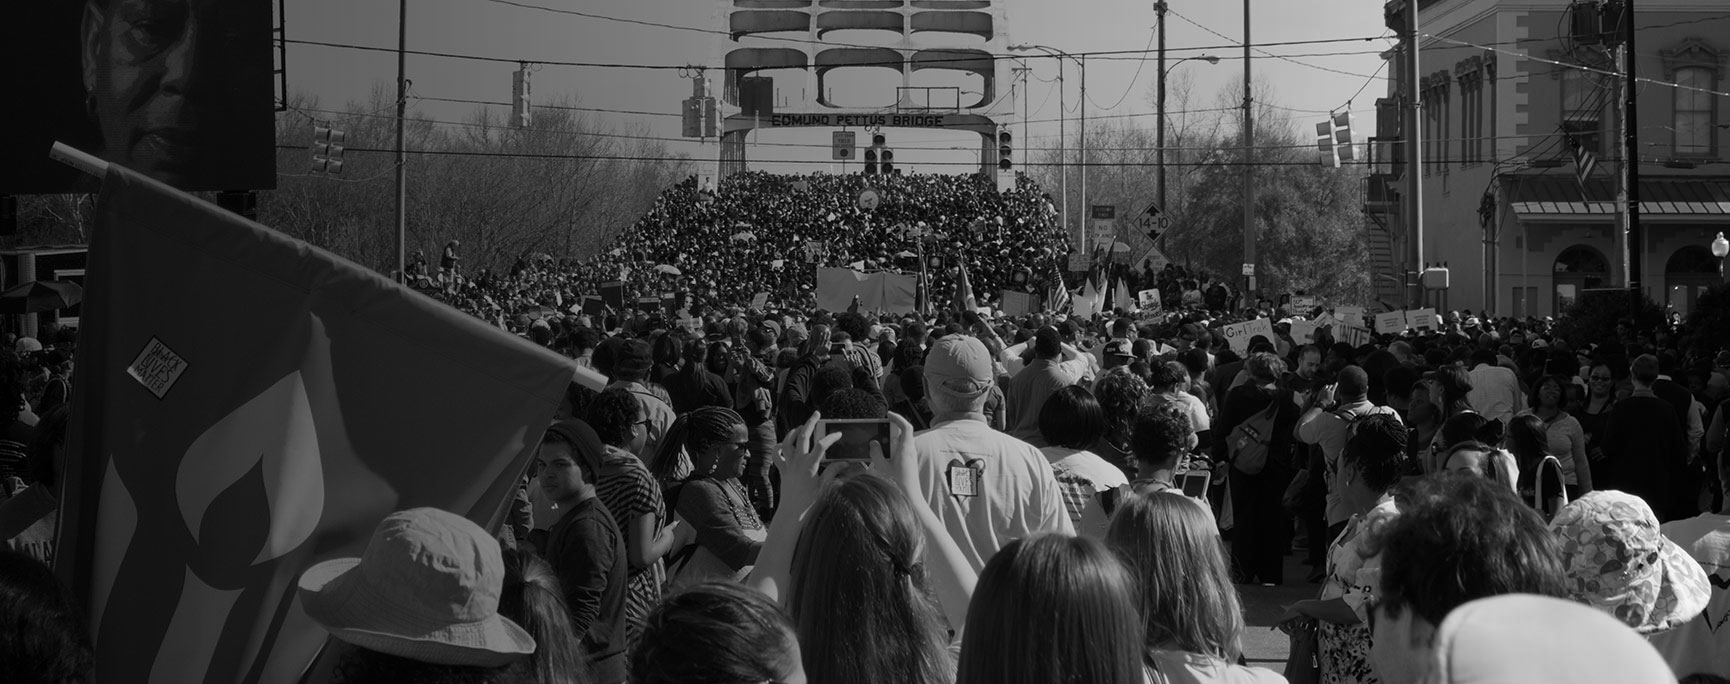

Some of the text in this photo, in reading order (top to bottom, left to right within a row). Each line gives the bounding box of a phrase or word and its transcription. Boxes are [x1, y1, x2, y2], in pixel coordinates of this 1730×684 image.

[771, 115, 944, 126] EDMUND PETTUS BRIDGE
[1139, 217, 1168, 229] 14-10
[141, 353, 174, 383] LIVES
[150, 342, 183, 372] BLACK
[134, 365, 164, 392] MATTER
